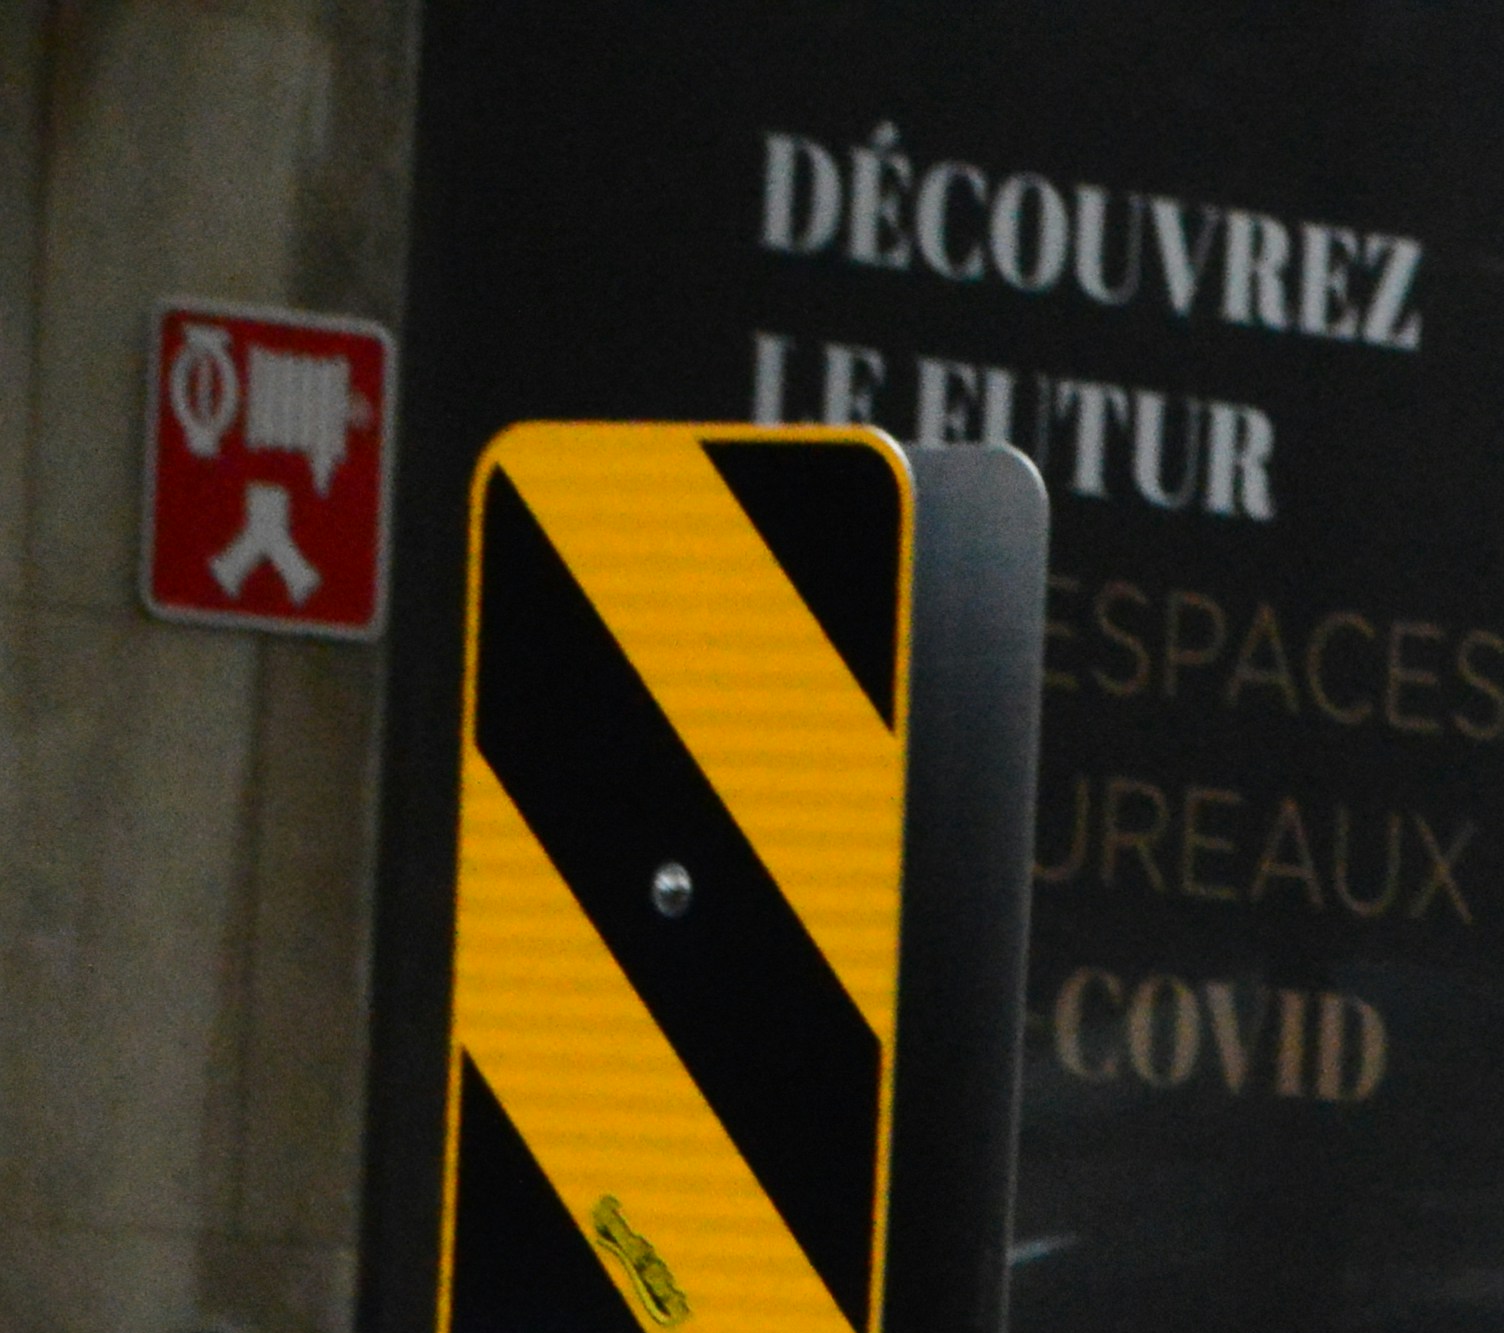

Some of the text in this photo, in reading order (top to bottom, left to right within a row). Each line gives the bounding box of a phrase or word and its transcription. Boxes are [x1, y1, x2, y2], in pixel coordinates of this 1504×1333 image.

[756, 120, 1423, 353] DÉCOUVREZ
[914, 354, 1276, 523] FUTUR
[1032, 778, 1478, 926] UREAUX
